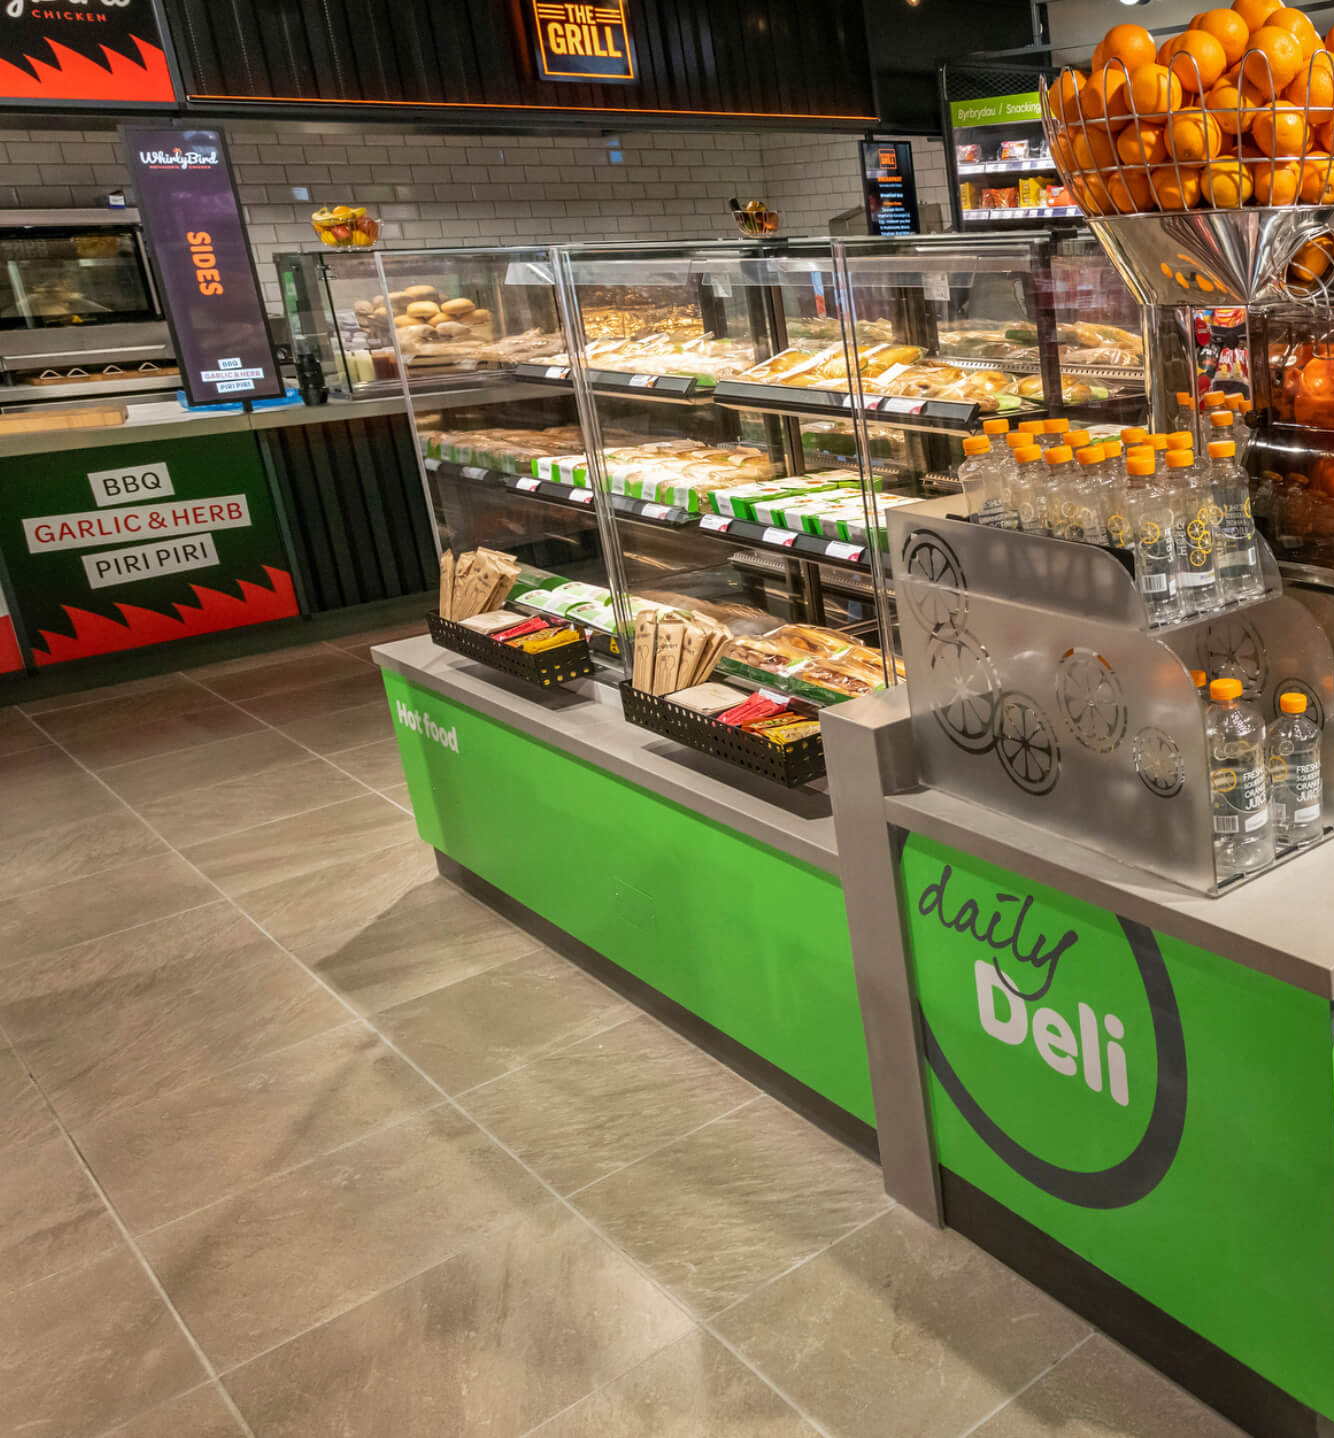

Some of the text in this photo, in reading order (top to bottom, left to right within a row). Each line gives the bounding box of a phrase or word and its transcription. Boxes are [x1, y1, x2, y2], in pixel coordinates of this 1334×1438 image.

[31, 9, 107, 22] CHICKEN
[564, 3, 596, 24] THE
[547, 22, 622, 58] GRILL
[957, 106, 996, 121] Byrbrydau
[1005, 102, 1041, 117] Snacking
[139, 151, 218, 170] WhirlyBird
[186, 231, 224, 296] SIDES
[103, 471, 162, 497] BBQ
[34, 502, 243, 543] GARLIC & HERB
[95, 541, 208, 579] PIRI PIRI
[396, 700, 460, 753] Hot food
[919, 865, 1078, 1001] daily
[974, 959, 1129, 1106] Deli
